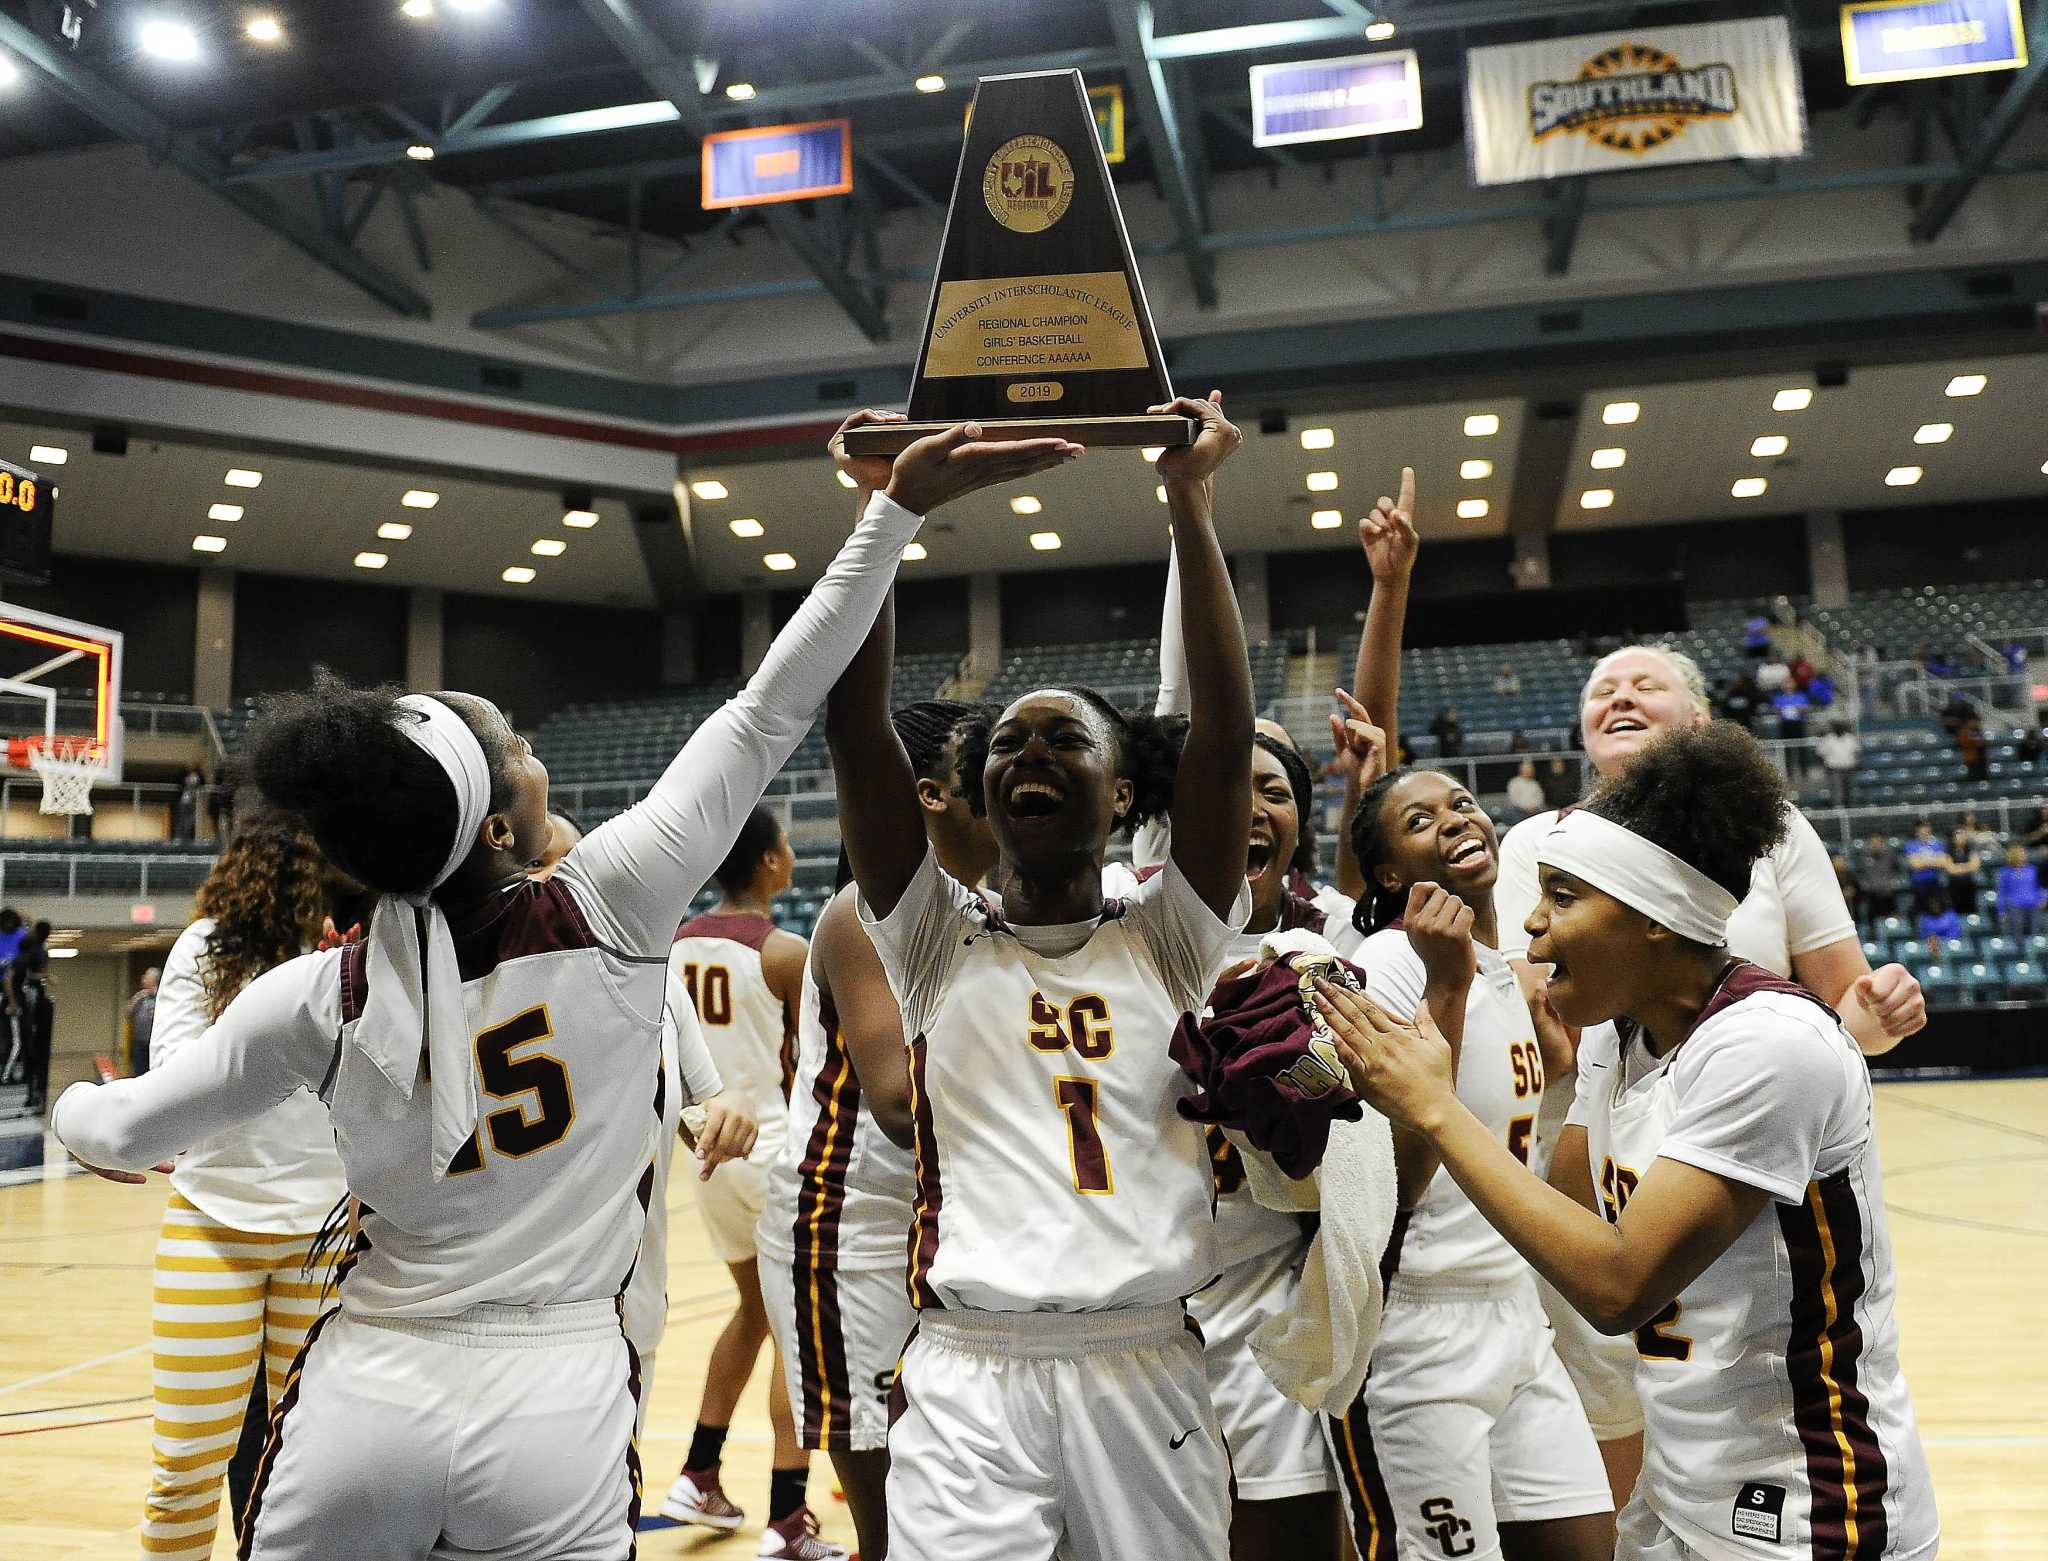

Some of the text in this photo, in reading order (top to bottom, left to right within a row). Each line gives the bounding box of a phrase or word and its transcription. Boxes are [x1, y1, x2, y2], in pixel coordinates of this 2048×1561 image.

[1529, 65, 1738, 138] SOUTHLAND
[1001, 155, 1057, 199] UIL
[935, 285, 1134, 339] UNIVERSITY INTERSCHOLASTIC LEAGUE
[979, 315, 1088, 331] REGIONAL CHAMPION
[976, 352, 1092, 367] CONFERENCE AAAAAA
[983, 334, 1085, 348] GIRLS' BASKETBALL
[1020, 385, 1051, 398] 2019
[682, 962, 733, 1027] 10
[1027, 988, 1115, 1060] SC
[1508, 1040, 1543, 1098] SC
[1053, 1075, 1114, 1195] 1
[1751, 1489, 1766, 1505] S
[1419, 1497, 1476, 1557] SC
